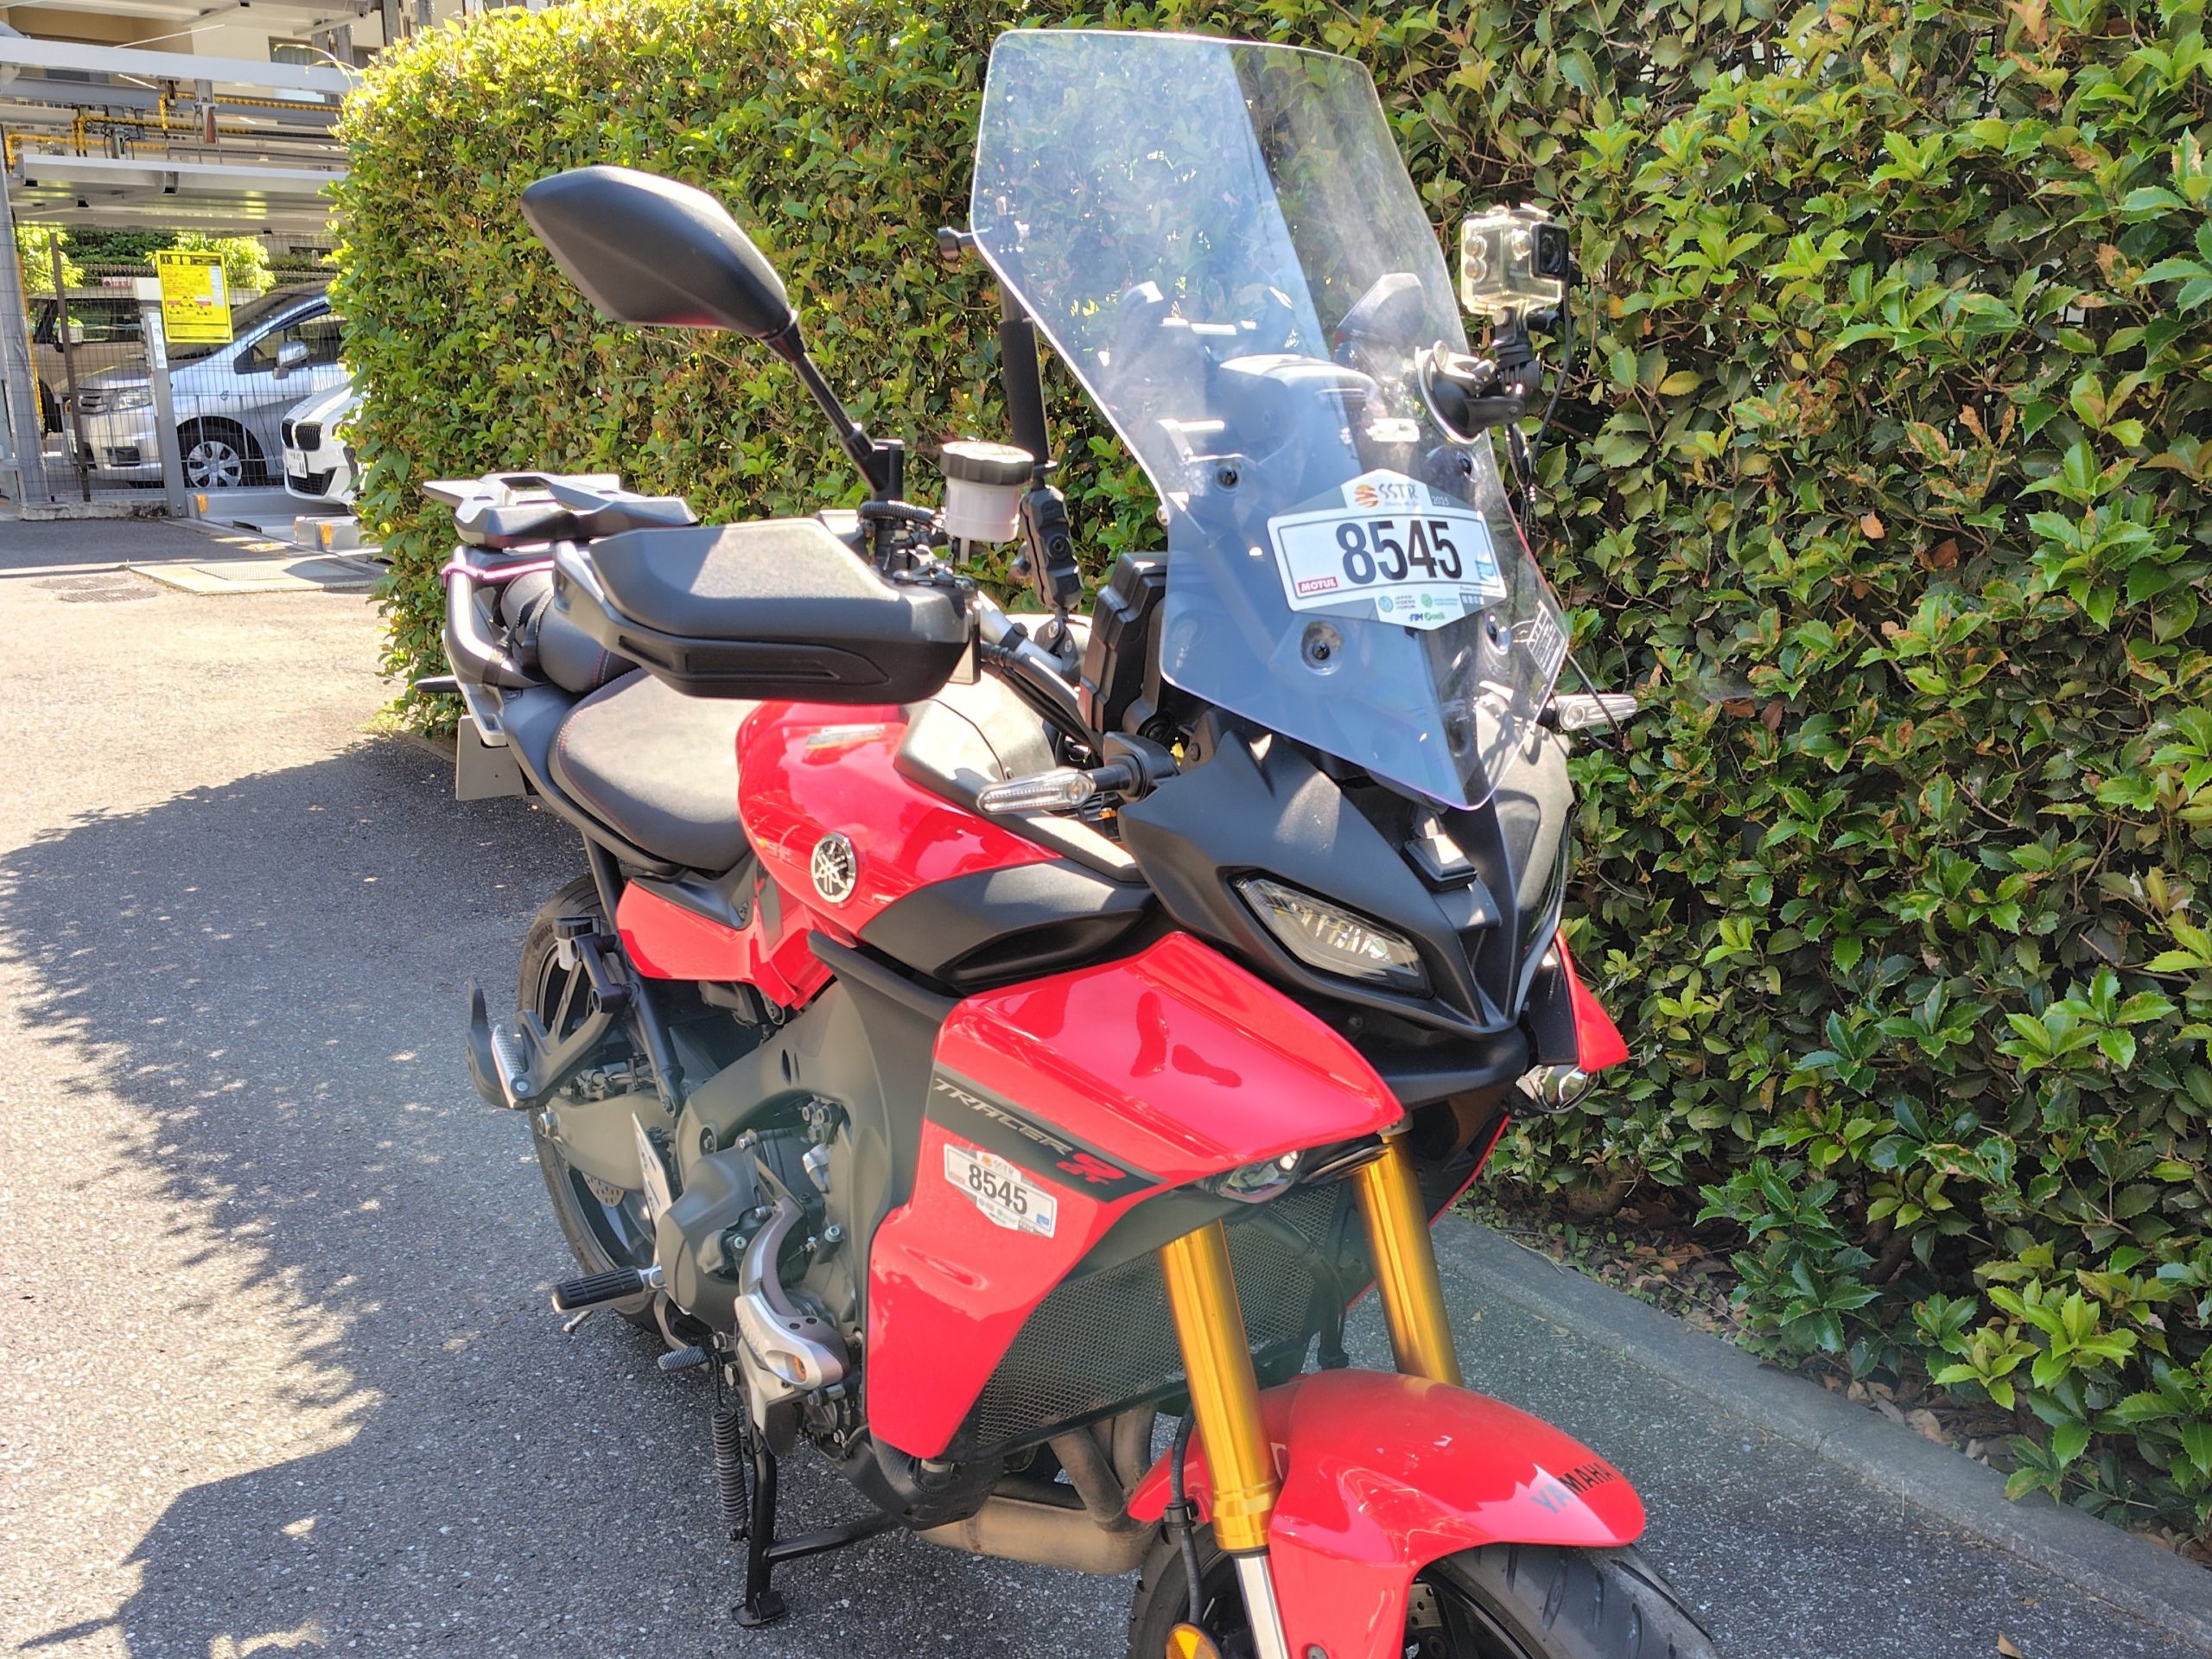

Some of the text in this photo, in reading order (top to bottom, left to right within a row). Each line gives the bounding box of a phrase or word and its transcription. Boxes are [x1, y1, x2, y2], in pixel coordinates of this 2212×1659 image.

[1378, 483, 1450, 505] SSTR 2025
[1336, 519, 1463, 585] 8545
[1300, 578, 1337, 593] MOTUL
[933, 1077, 1073, 1156] TRACER
[968, 1163, 1027, 1216] 8545
[1529, 1462, 1618, 1514] YAMAHA
